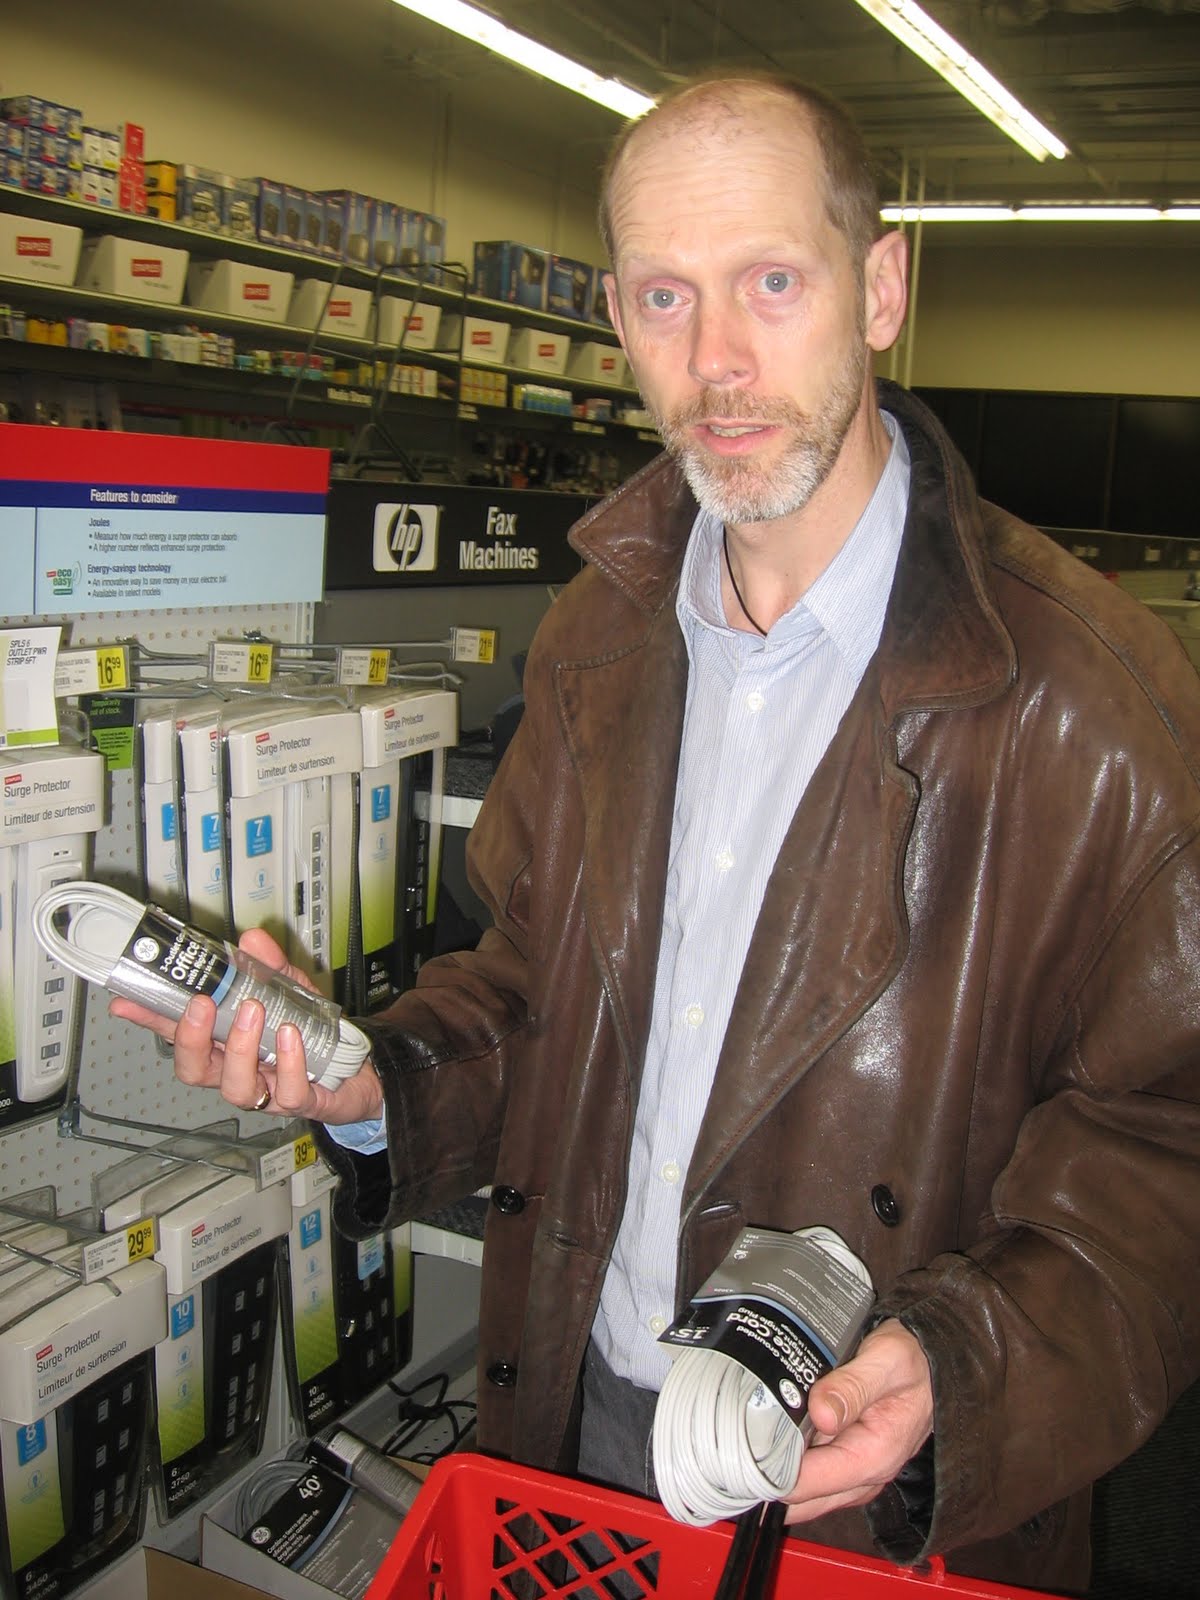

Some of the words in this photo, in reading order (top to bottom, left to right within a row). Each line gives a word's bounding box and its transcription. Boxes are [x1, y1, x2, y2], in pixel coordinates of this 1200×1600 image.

[90, 488, 128, 502] Features
[131, 490, 139, 503] to
[141, 490, 177, 504] consider
[88, 518, 110, 527] Joules
[486, 506, 517, 536] Fax
[94, 532, 118, 541] Measure
[119, 532, 131, 540] how
[173, 534, 187, 542] surge
[188, 533, 209, 542] protector
[99, 544, 116, 553] higher
[187, 545, 200, 553] surge
[459, 540, 539, 570] Machines
[57, 568, 72, 577] eco
[88, 564, 136, 575] Energy-savings
[138, 563, 171, 573] technology
[53, 577, 72, 587] easy
[92, 578, 100, 586] An
[130, 579, 141, 587] way
[163, 577, 180, 586] money
[8, 647, 32, 657] OUTLET
[32, 646, 48, 656] PWR
[10, 639, 26, 648] SPLS
[7, 657, 26, 666] STRIP
[384, 719, 401, 731] Surge
[401, 713, 424, 727] Protector
[256, 744, 278, 756] Surge
[280, 736, 312, 751] Protector
[384, 739, 407, 752] Limiteur
[257, 764, 287, 779] Limiteur
[288, 762, 298, 773] de
[299, 755, 336, 771] surtension
[4, 785, 31, 798] Surge
[33, 779, 71, 794] Protector
[377, 787, 385, 804] 7
[4, 812, 40, 826] Limiteur
[42, 809, 53, 820] de
[54, 802, 96, 819] surtension
[210, 815, 219, 832] 7
[254, 819, 263, 837] 7
[160, 941, 181, 973] 3-Outlet
[171, 941, 200, 980] Office
[186, 965, 199, 985] with
[194, 948, 208, 971] Right
[192, 1232, 213, 1248] Surge
[214, 1215, 242, 1237] Protector
[303, 1213, 317, 1232] 12
[192, 1251, 220, 1272] Limiteur
[221, 1245, 230, 1256] de
[231, 1227, 262, 1251] surtension
[176, 1300, 190, 1319] 10
[737, 1306, 758, 1318] Plug
[725, 1312, 770, 1337] Cord
[759, 1316, 783, 1335] Angle
[736, 1325, 780, 1359] Grounded
[783, 1335, 802, 1355] Right
[36, 1353, 63, 1373] Surge
[64, 1330, 101, 1358] Protector
[772, 1335, 815, 1384] Office
[38, 1372, 74, 1399] Limiteur
[75, 1365, 86, 1378] de
[88, 1340, 127, 1370] surtension
[802, 1355, 820, 1373] with
[779, 1356, 810, 1392] 3-Outlet
[308, 1385, 317, 1397] 10
[25, 1424, 37, 1441] 8
[171, 1467, 177, 1478] 6
[25, 1571, 32, 1581] 6
